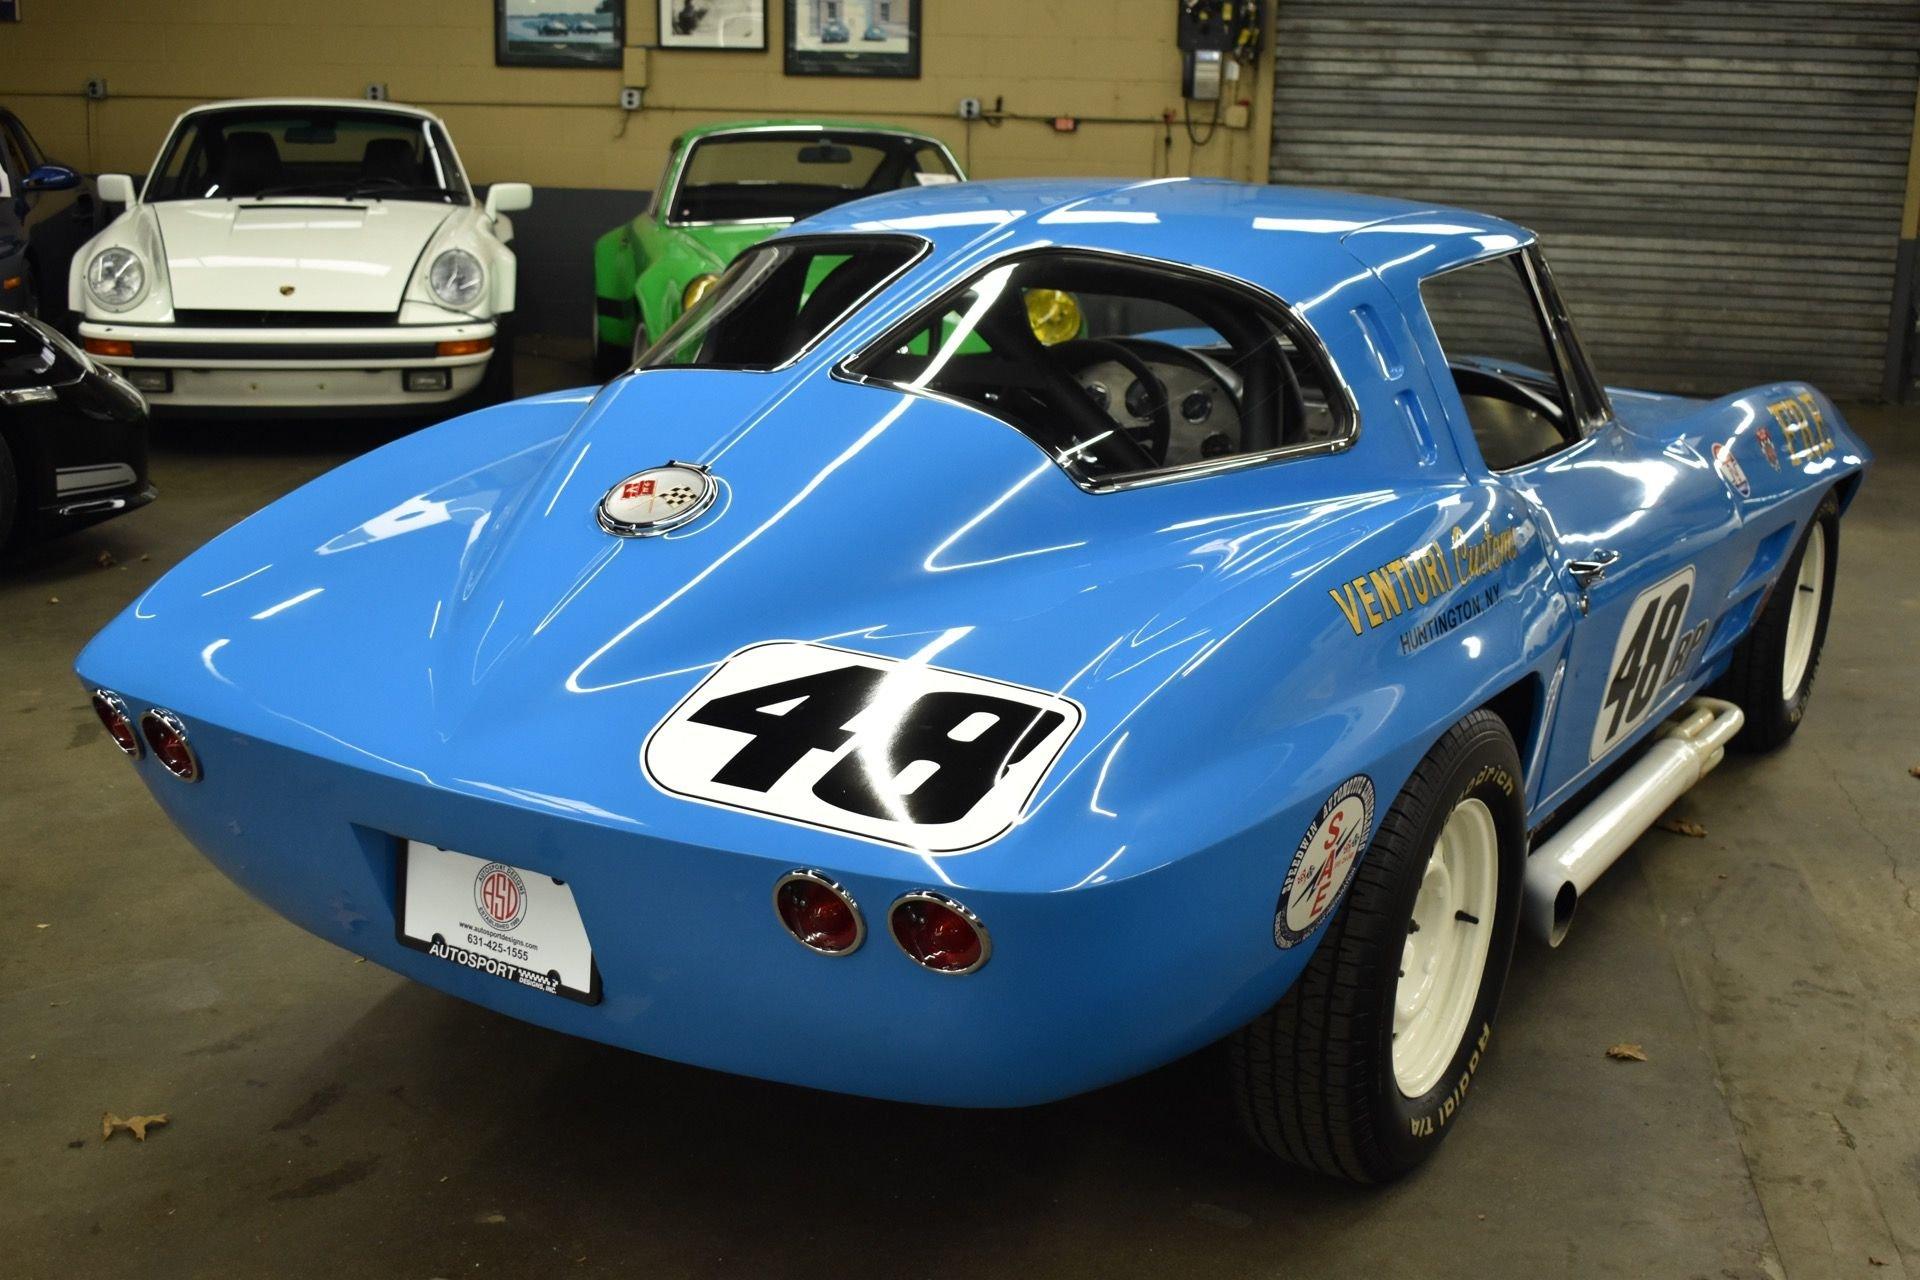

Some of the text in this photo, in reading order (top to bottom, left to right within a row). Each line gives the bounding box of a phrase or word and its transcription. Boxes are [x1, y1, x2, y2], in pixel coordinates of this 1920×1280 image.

[1328, 540, 1453, 636] VENTURI
[1603, 583, 1690, 745] 48
[686, 664, 1066, 825] 48
[478, 863, 525, 896] AUTOSPORT DESIGNS
[1281, 820, 1318, 893] SPEEDWIN
[1309, 811, 1345, 919] SAE
[483, 873, 518, 921] ASD
[429, 943, 517, 980] AUTOSPORT
[458, 921, 539, 951] www.autosportdesigns.com
[467, 933, 529, 962] 631-425-1555
[1410, 1022, 1491, 1138] Radial T/A
